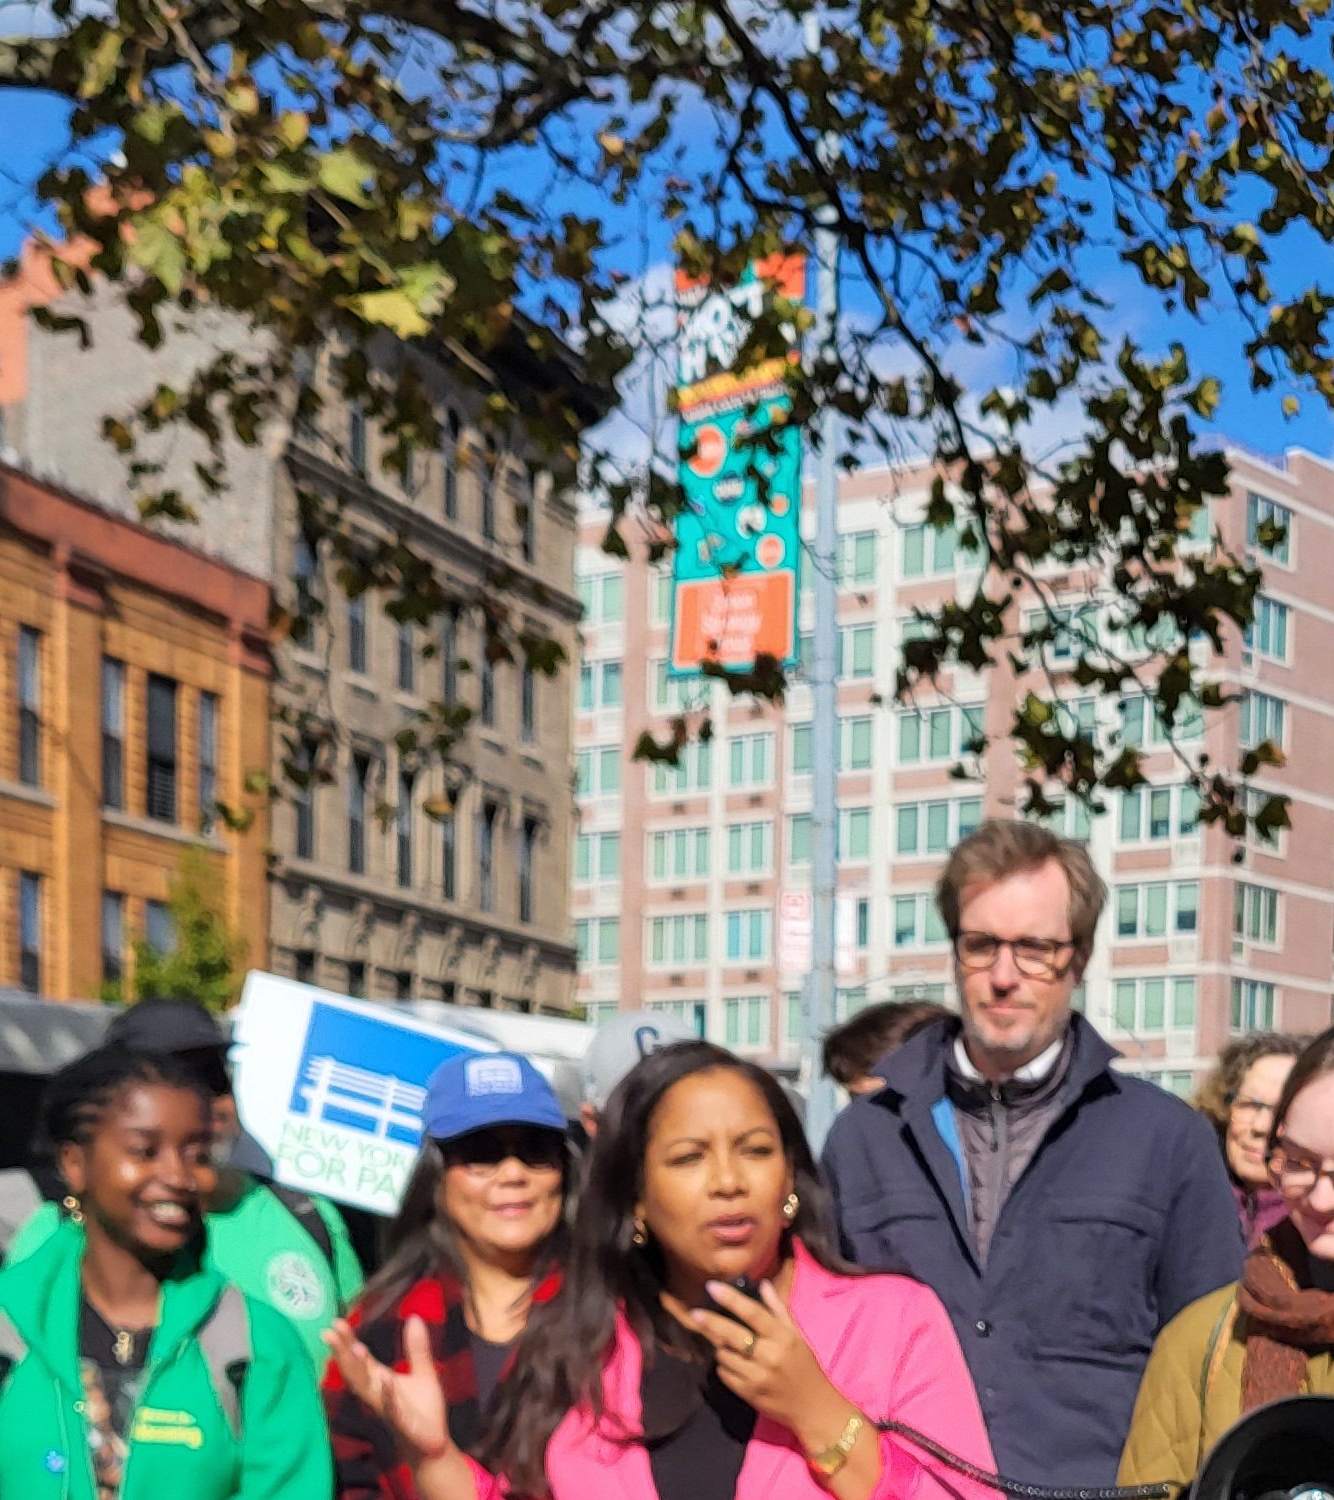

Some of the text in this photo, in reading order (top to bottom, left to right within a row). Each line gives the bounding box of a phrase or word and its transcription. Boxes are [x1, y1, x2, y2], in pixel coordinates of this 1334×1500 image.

[277, 1142, 397, 1198] FOR PA
[281, 1120, 405, 1168] NEW YOR
